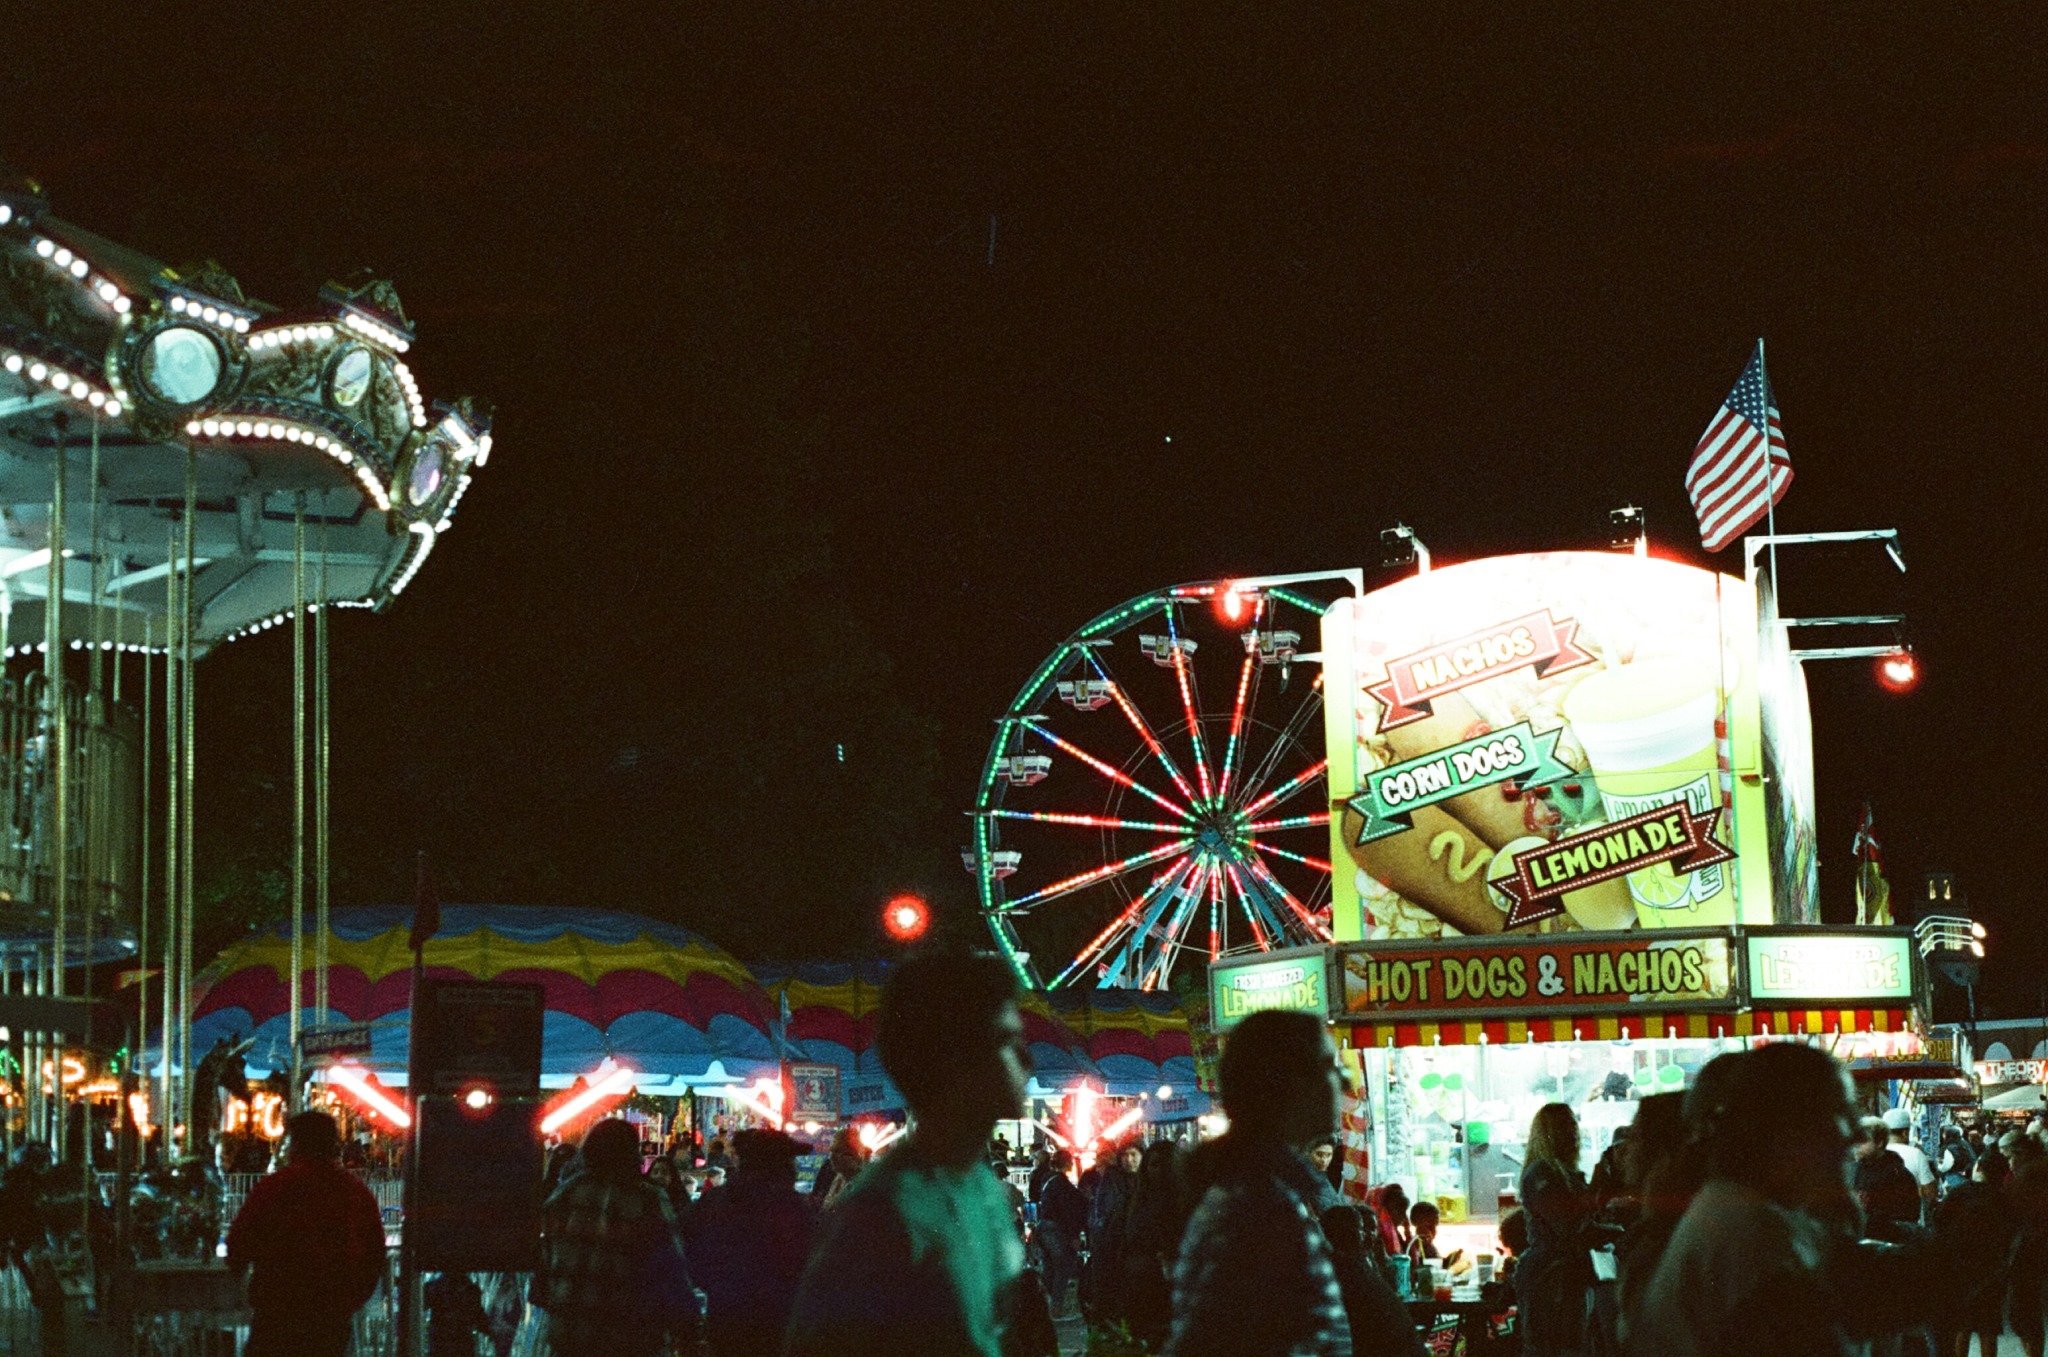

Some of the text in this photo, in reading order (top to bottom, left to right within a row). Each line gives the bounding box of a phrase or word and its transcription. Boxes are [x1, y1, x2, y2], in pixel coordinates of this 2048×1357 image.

[1411, 627, 1535, 692] NACHOS
[1379, 735, 1526, 807] CORN DOGS
[1530, 818, 1686, 888] LEMONADE
[1368, 947, 1703, 1004] HOT DOGS & NACHOS
[1989, 1060, 2046, 1075] THEORY
